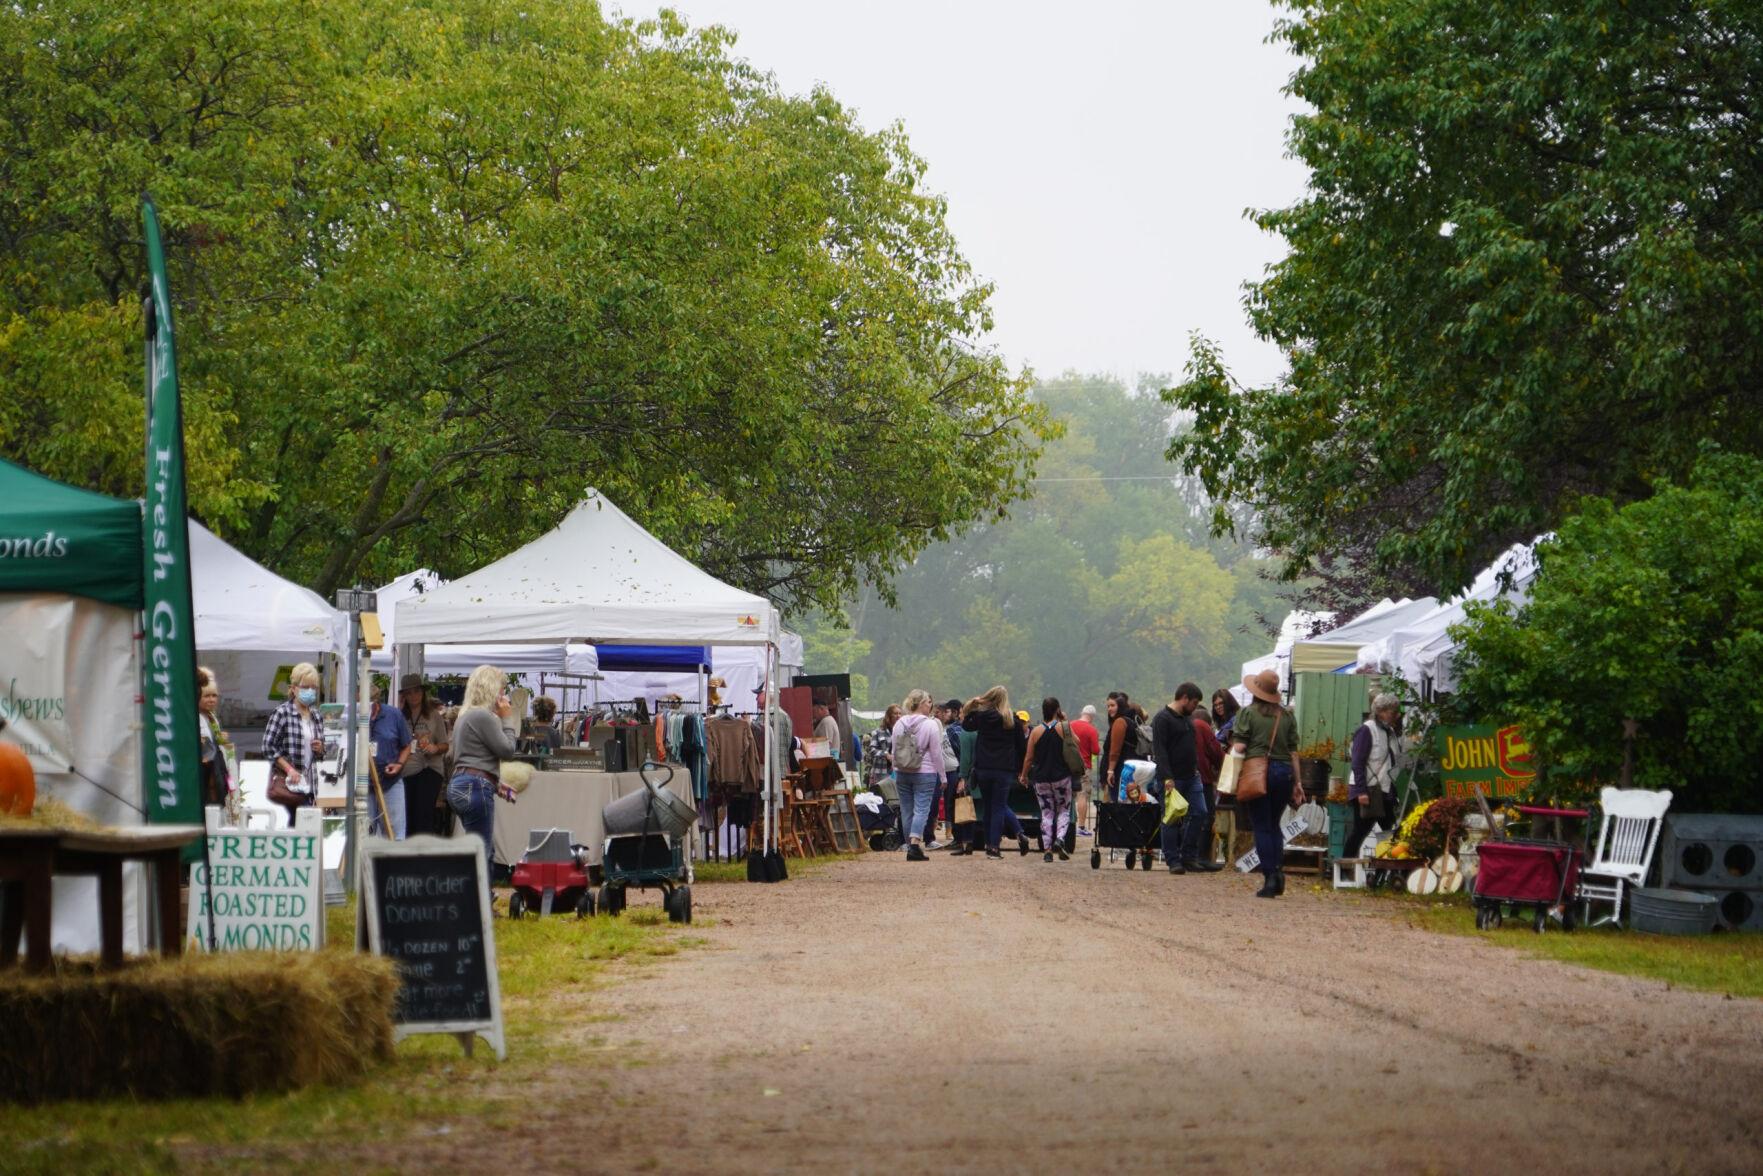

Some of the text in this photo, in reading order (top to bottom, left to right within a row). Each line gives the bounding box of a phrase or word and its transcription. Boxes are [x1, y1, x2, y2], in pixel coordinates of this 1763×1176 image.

[153, 446, 178, 810] Fresh German
[1442, 736, 1496, 770] JOHN
[195, 864, 312, 888] GERMAN
[194, 922, 312, 952] AMONDS
[404, 941, 449, 954] DOZEN
